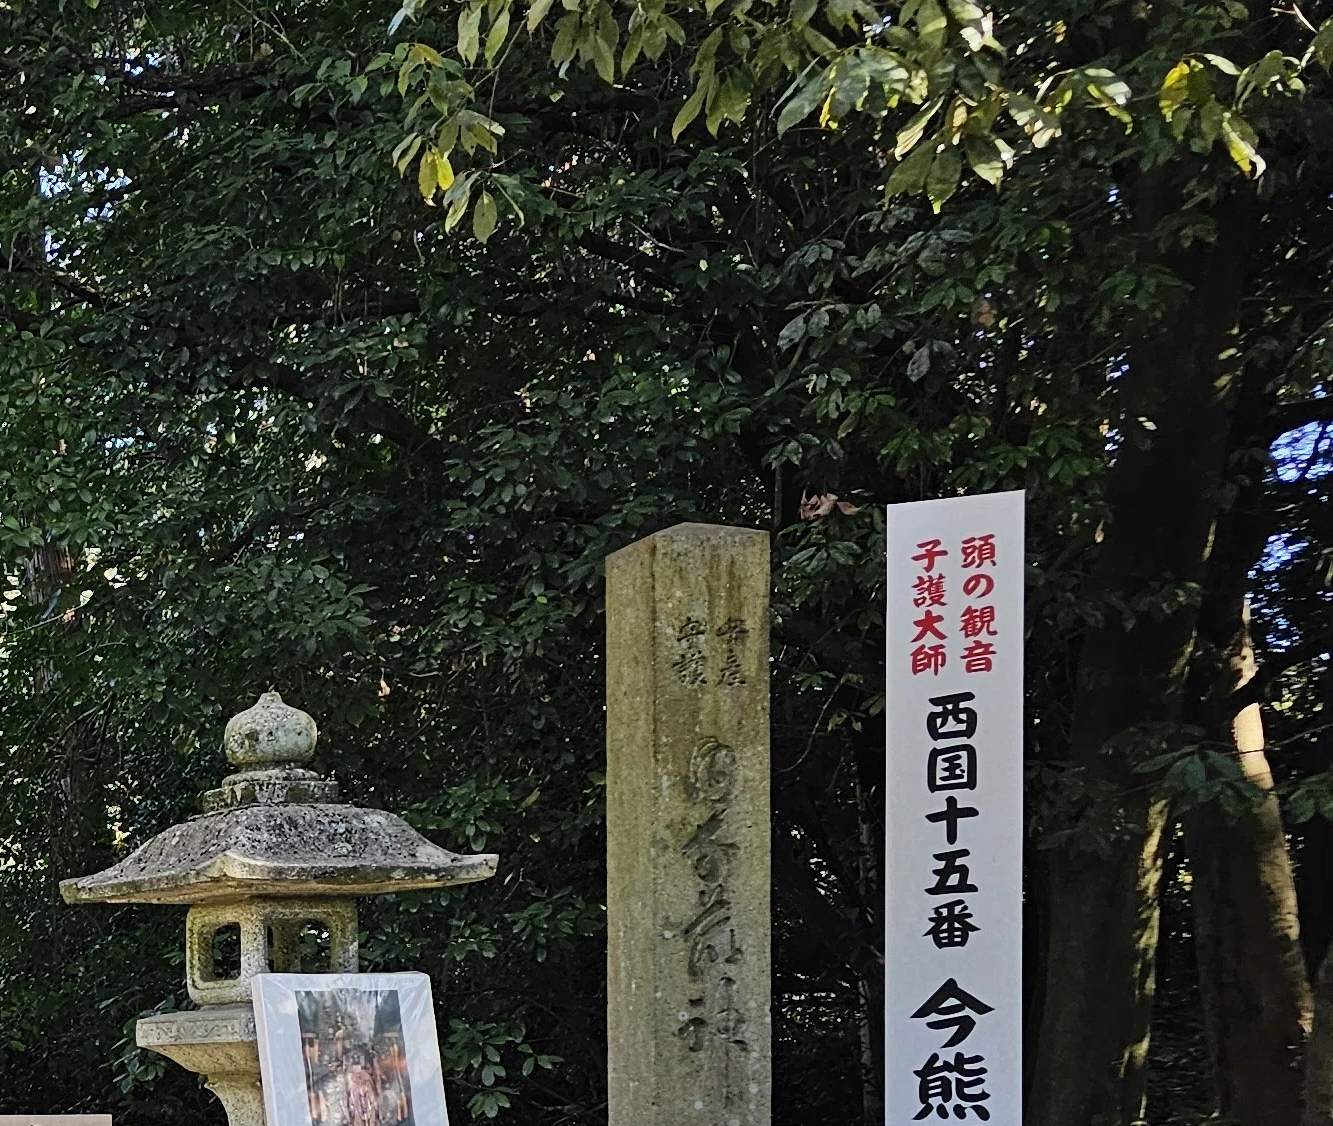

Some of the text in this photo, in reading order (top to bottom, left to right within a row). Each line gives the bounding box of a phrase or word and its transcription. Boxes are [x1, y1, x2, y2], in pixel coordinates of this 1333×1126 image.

[910, 539, 948, 677] 子護大師
[959, 533, 998, 674] 頭の観音
[921, 690, 981, 950] 西国十五番
